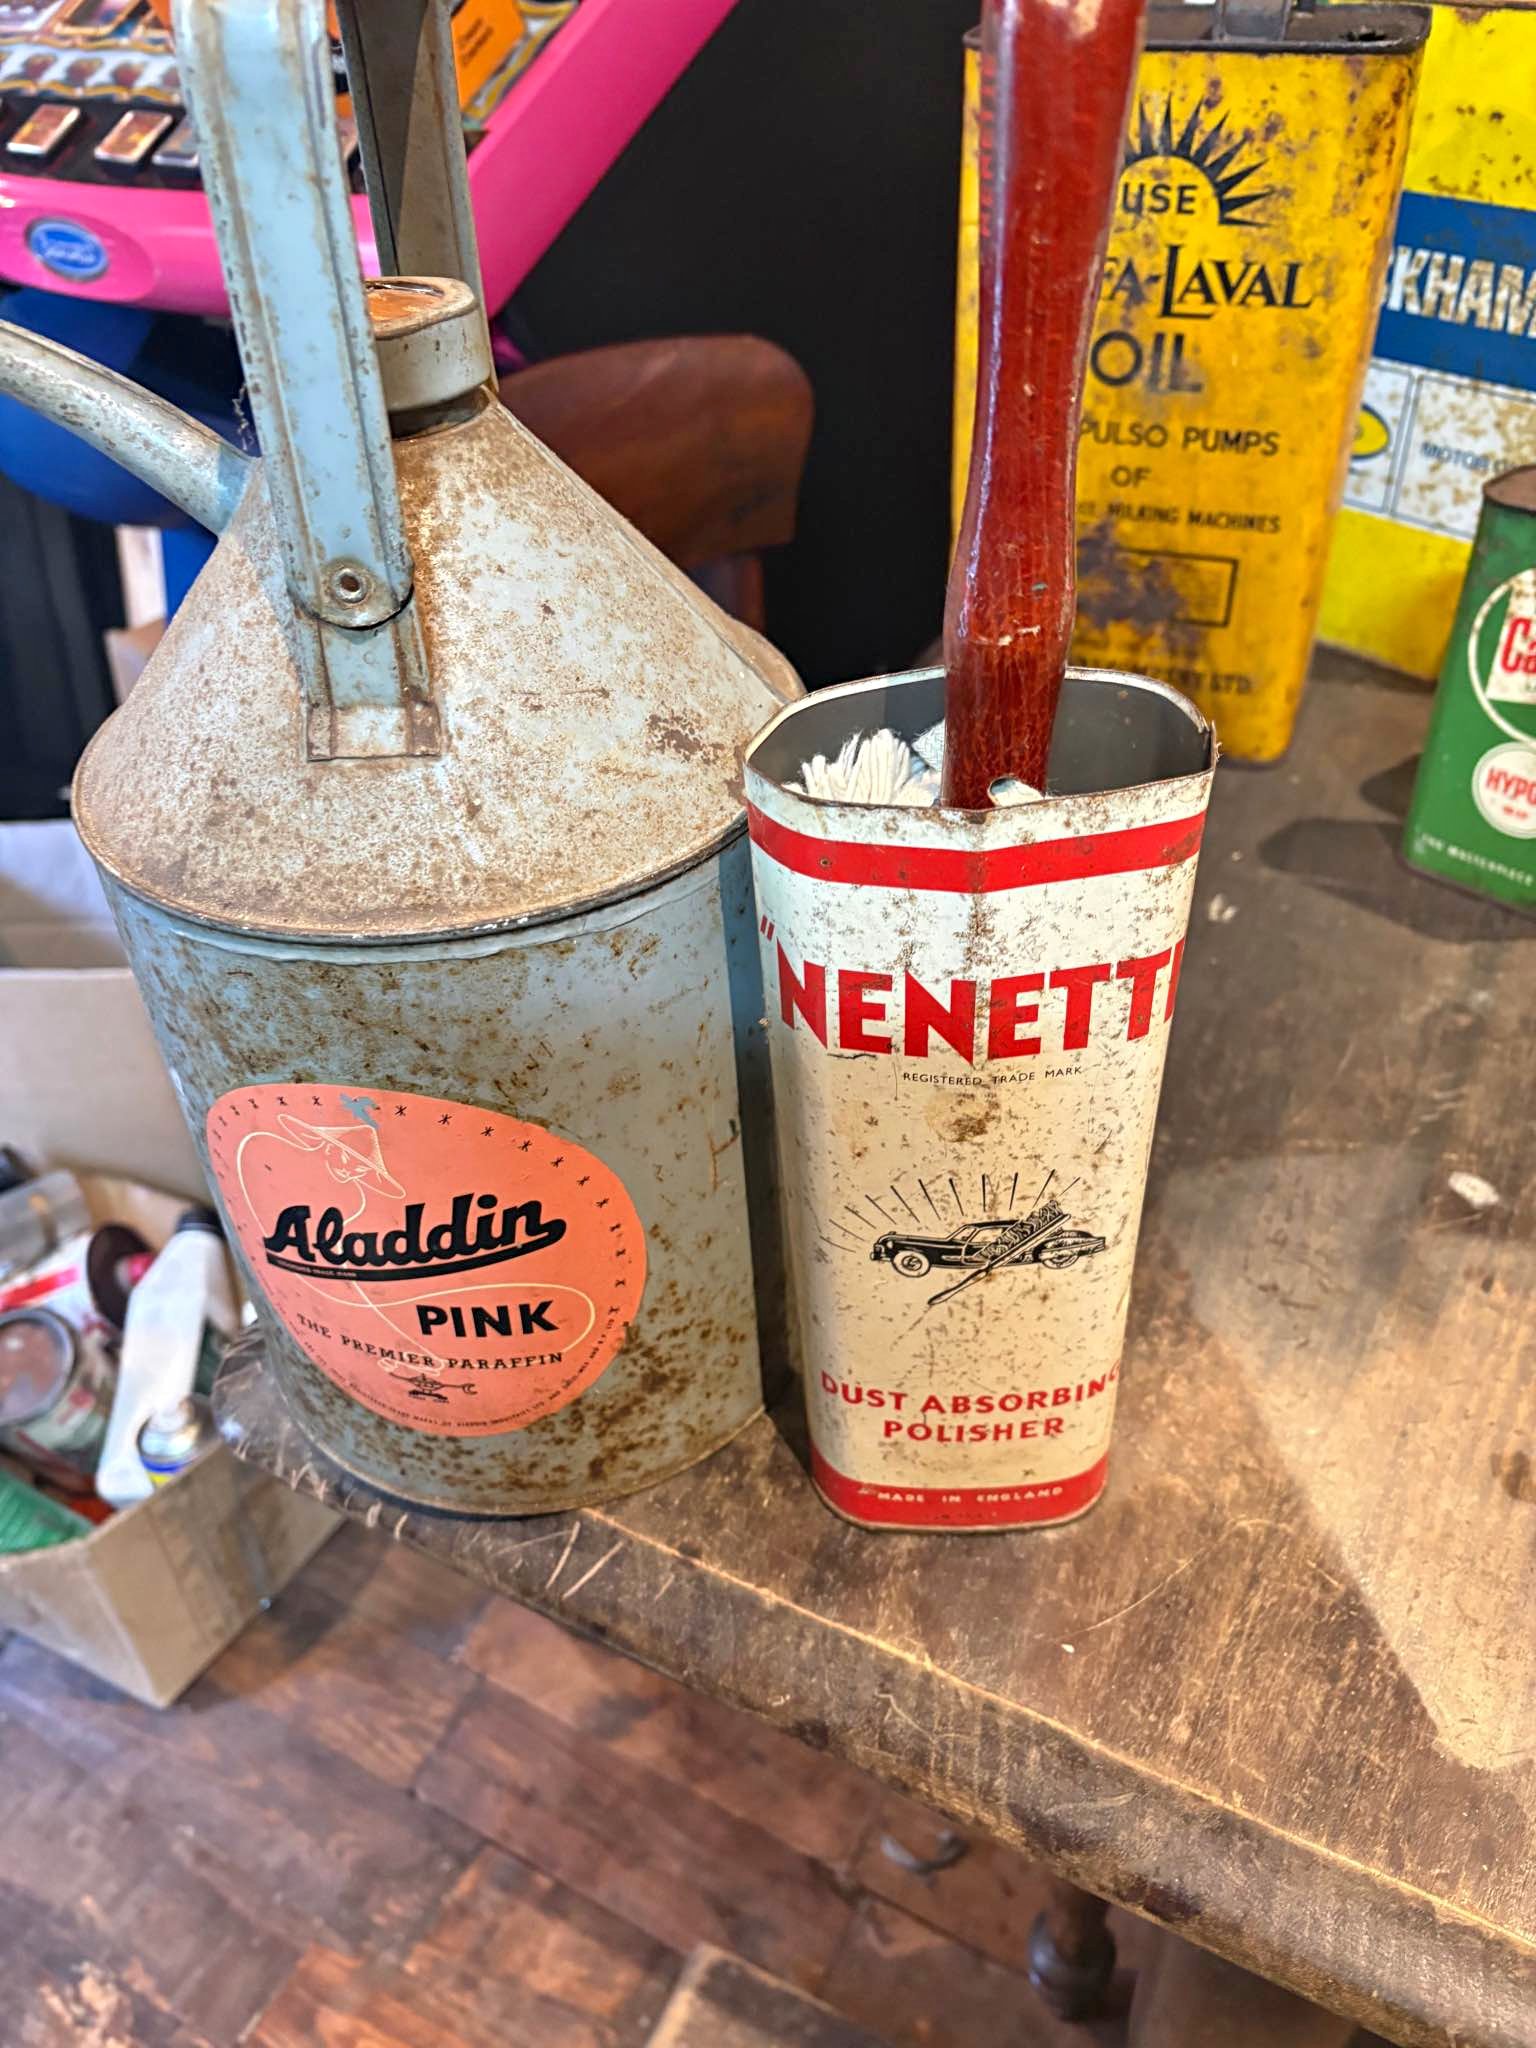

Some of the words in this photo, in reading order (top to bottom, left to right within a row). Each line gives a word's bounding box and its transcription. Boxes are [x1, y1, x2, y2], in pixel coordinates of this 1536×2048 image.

[1122, 182, 1198, 215] USE
[1383, 246, 1536, 338] KHAM
[1091, 331, 1203, 392] OIL
[1181, 426, 1280, 456] PUMPS
[1110, 465, 1150, 488] OF
[903, 1072, 983, 1086] REGISTERED
[991, 1071, 1036, 1085] TRADE
[1045, 1066, 1083, 1079] MARK
[263, 1192, 567, 1267] Aladdin
[416, 1300, 559, 1338] PINK
[297, 1313, 331, 1339] THE
[341, 1335, 435, 1367] PREMIER
[448, 1352, 563, 1370] PARAFFIN
[822, 1371, 908, 1410] DUST
[884, 1417, 1065, 1443] POLISHER
